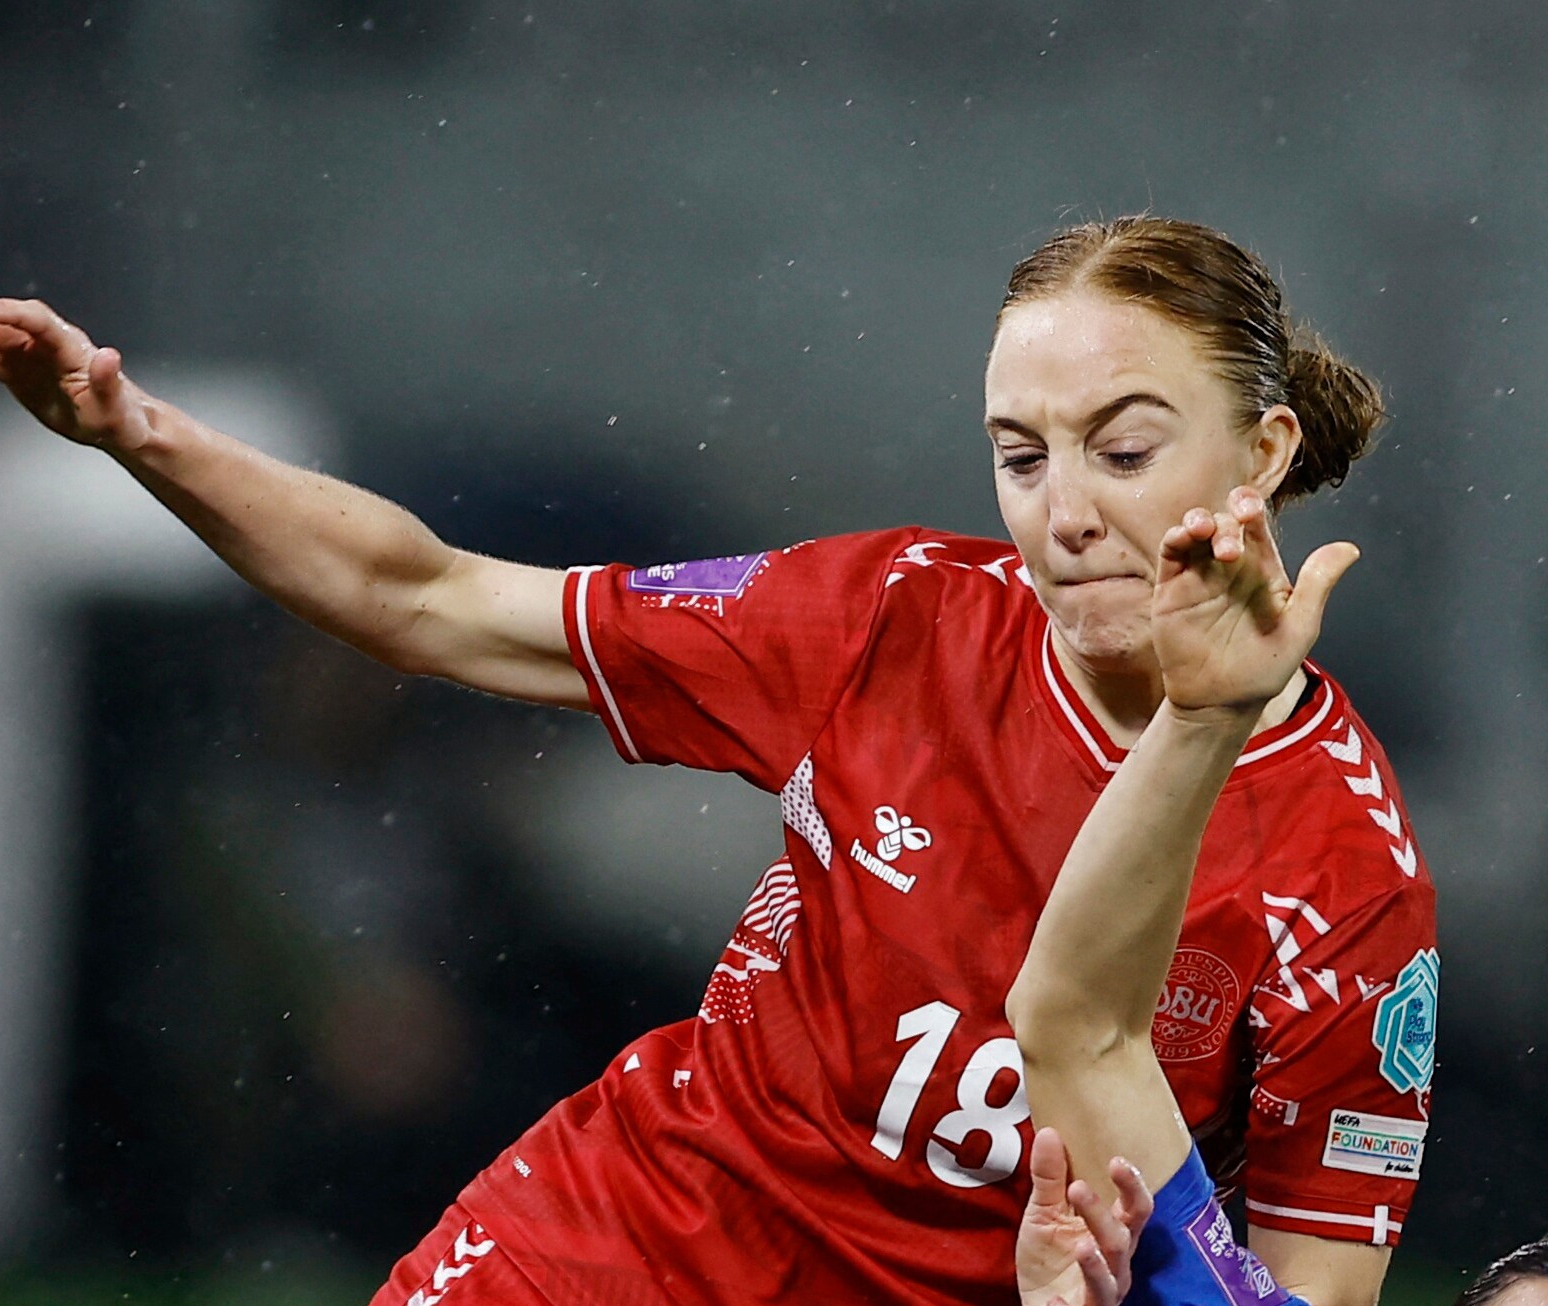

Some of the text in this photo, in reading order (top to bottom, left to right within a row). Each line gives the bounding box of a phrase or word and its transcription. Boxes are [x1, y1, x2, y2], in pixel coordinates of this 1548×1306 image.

[849, 838, 917, 894] hummel
[870, 1001, 1031, 1188] 18
[1334, 1113, 1360, 1128] UEFA
[1330, 1131, 1419, 1157] FOUNDATION
